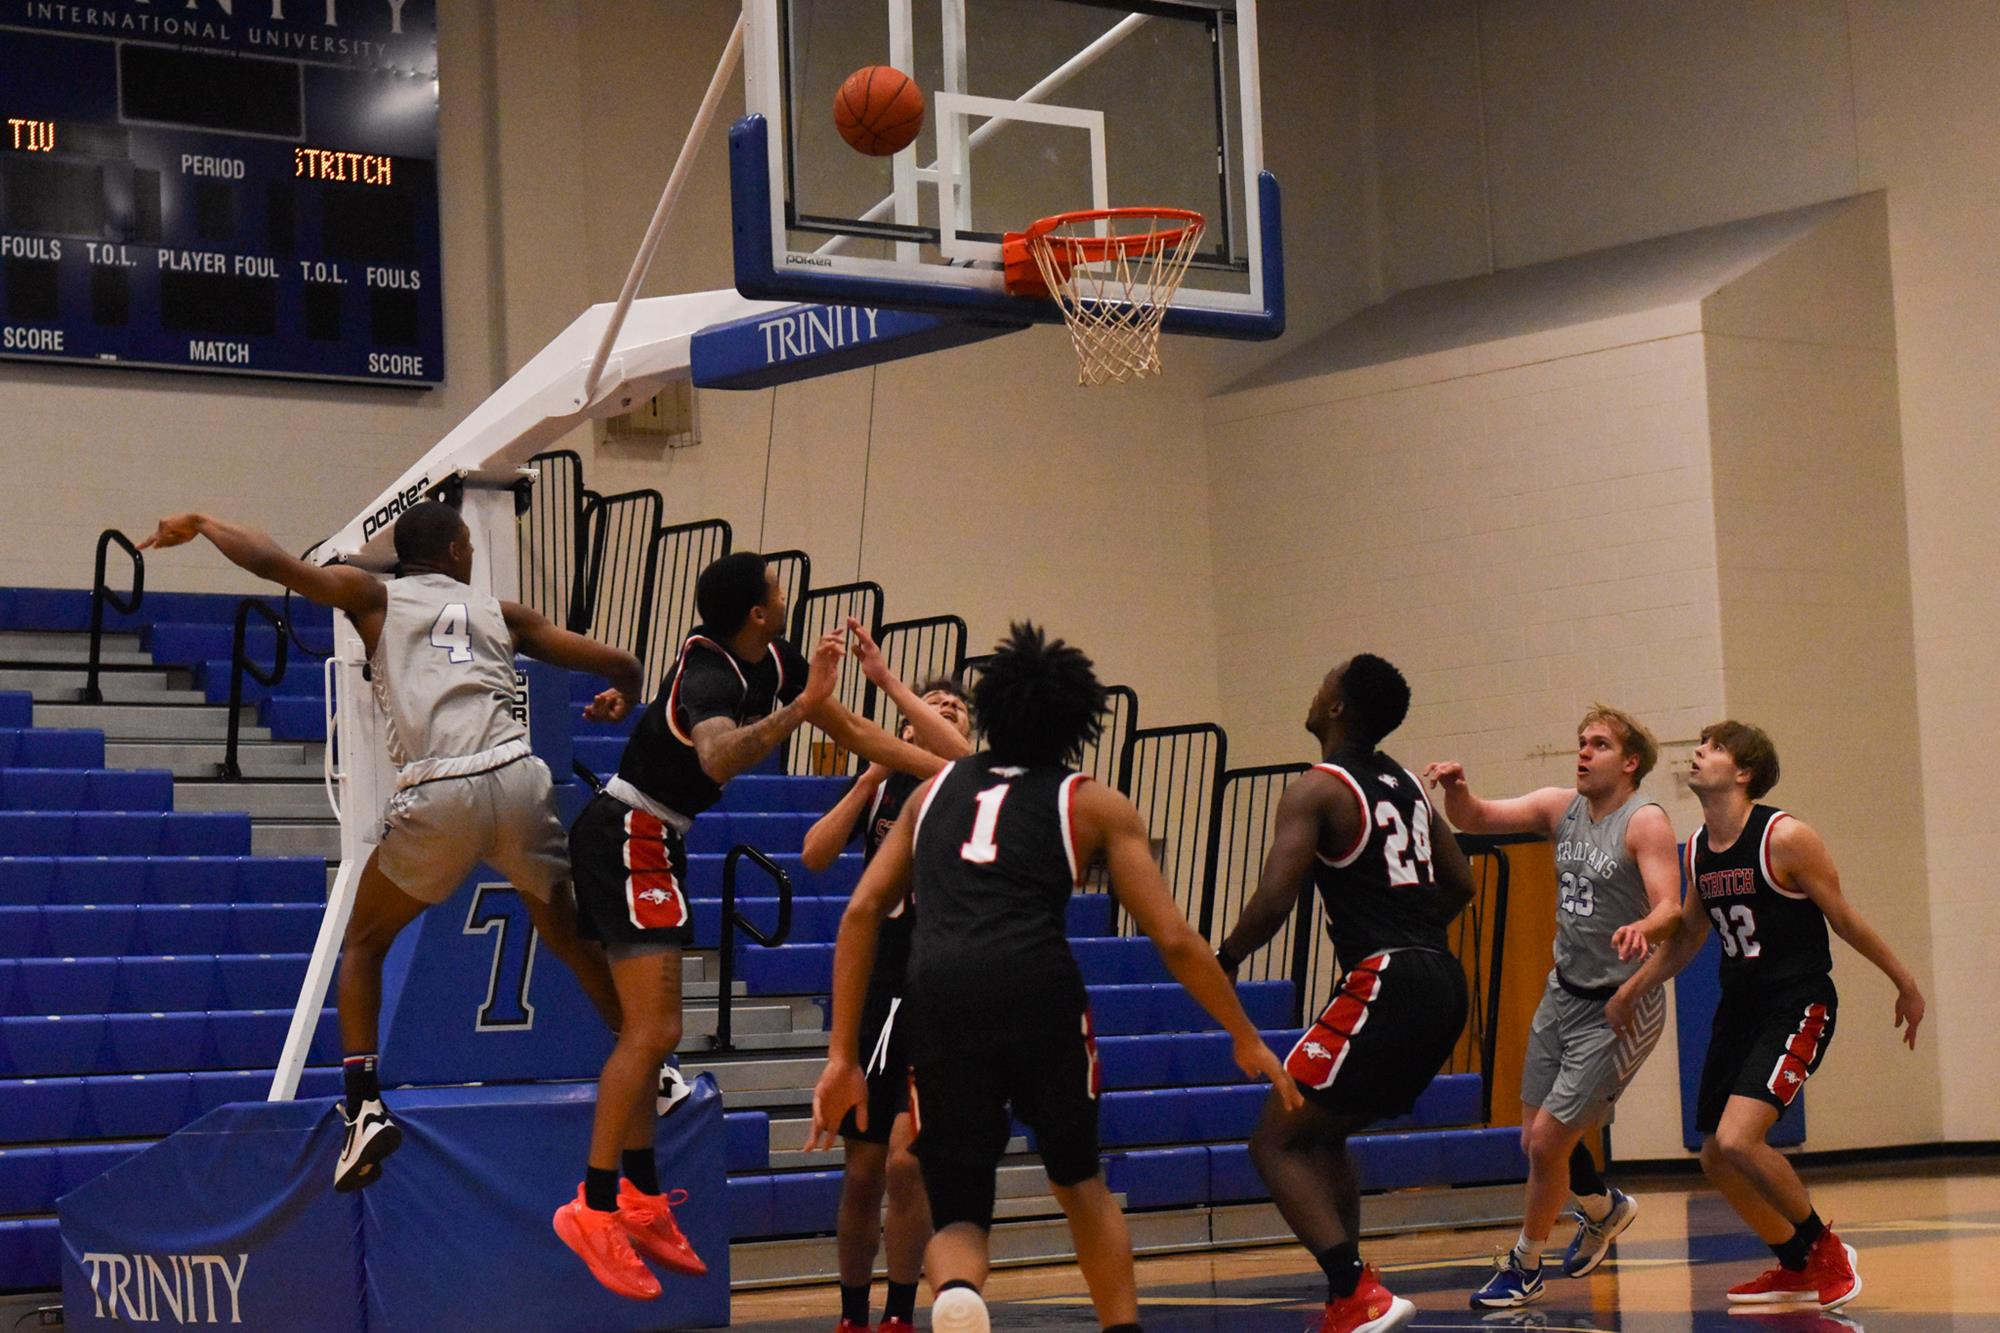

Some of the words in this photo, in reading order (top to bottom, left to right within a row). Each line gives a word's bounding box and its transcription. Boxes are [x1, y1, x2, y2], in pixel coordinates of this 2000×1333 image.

[27, 2, 231, 40] INTERNATIONAL
[248, 28, 386, 55] UNIVERSITY
[181, 154, 245, 179] PERIOD
[295, 148, 391, 185] STRITCH
[1, 236, 61, 261] FOULS
[86, 242, 137, 266] T.O.L.
[158, 249, 226, 274] PLAYER
[235, 255, 280, 278] FOUL
[300, 261, 348, 285] T.O.L.
[366, 267, 421, 290] FOULS
[3, 327, 64, 352] SCORE
[758, 304, 878, 364] TRINITY
[189, 340, 249, 365] MATCH
[368, 353, 423, 375] SCORE
[430, 603, 474, 664] 4
[960, 783, 1010, 864] 1
[1374, 799, 1436, 887] 24
[1560, 871, 1595, 917] 23
[1699, 867, 1756, 900] STRITCH
[81, 1252, 249, 1326] TRINITY
